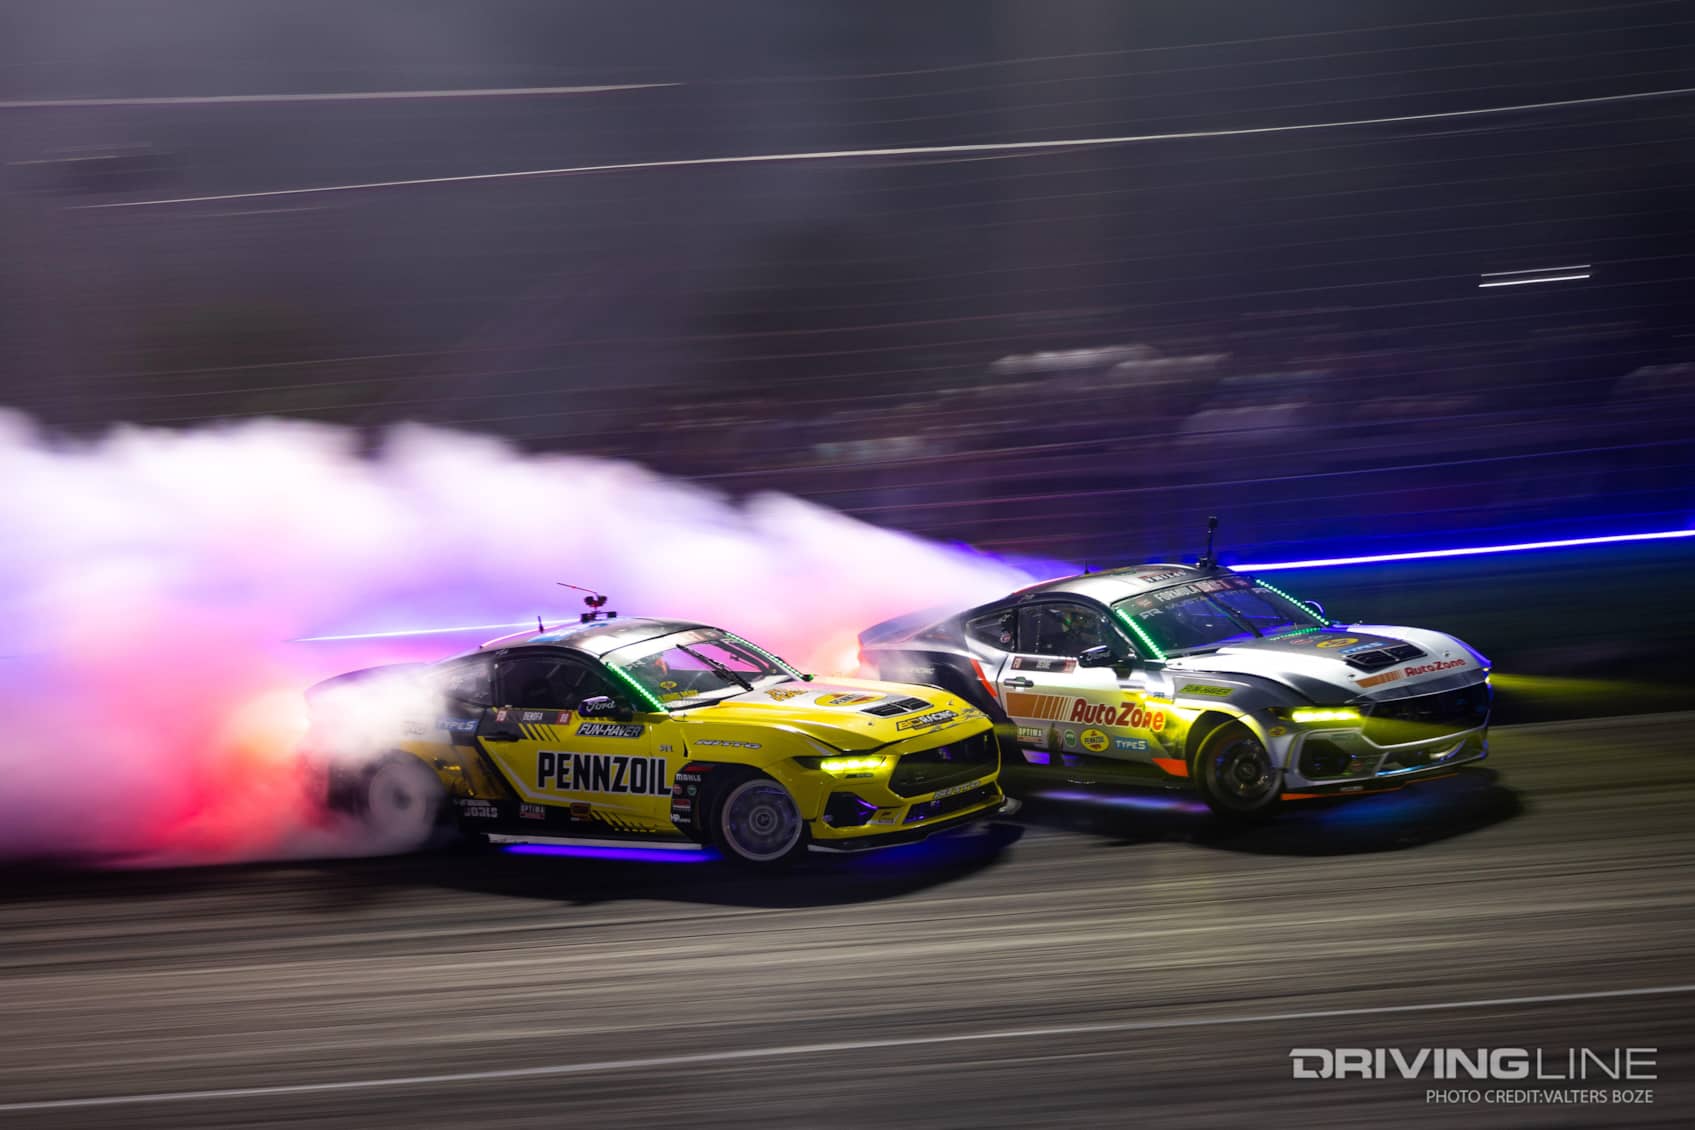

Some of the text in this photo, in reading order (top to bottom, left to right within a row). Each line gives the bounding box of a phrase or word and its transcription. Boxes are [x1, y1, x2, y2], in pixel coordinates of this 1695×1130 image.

[1404, 659, 1466, 676] AutoZone
[585, 701, 615, 713] Ford
[1069, 698, 1164, 731] AutoZone
[579, 723, 642, 737] FUN-HAVER
[537, 751, 672, 795] PENNZOIL
